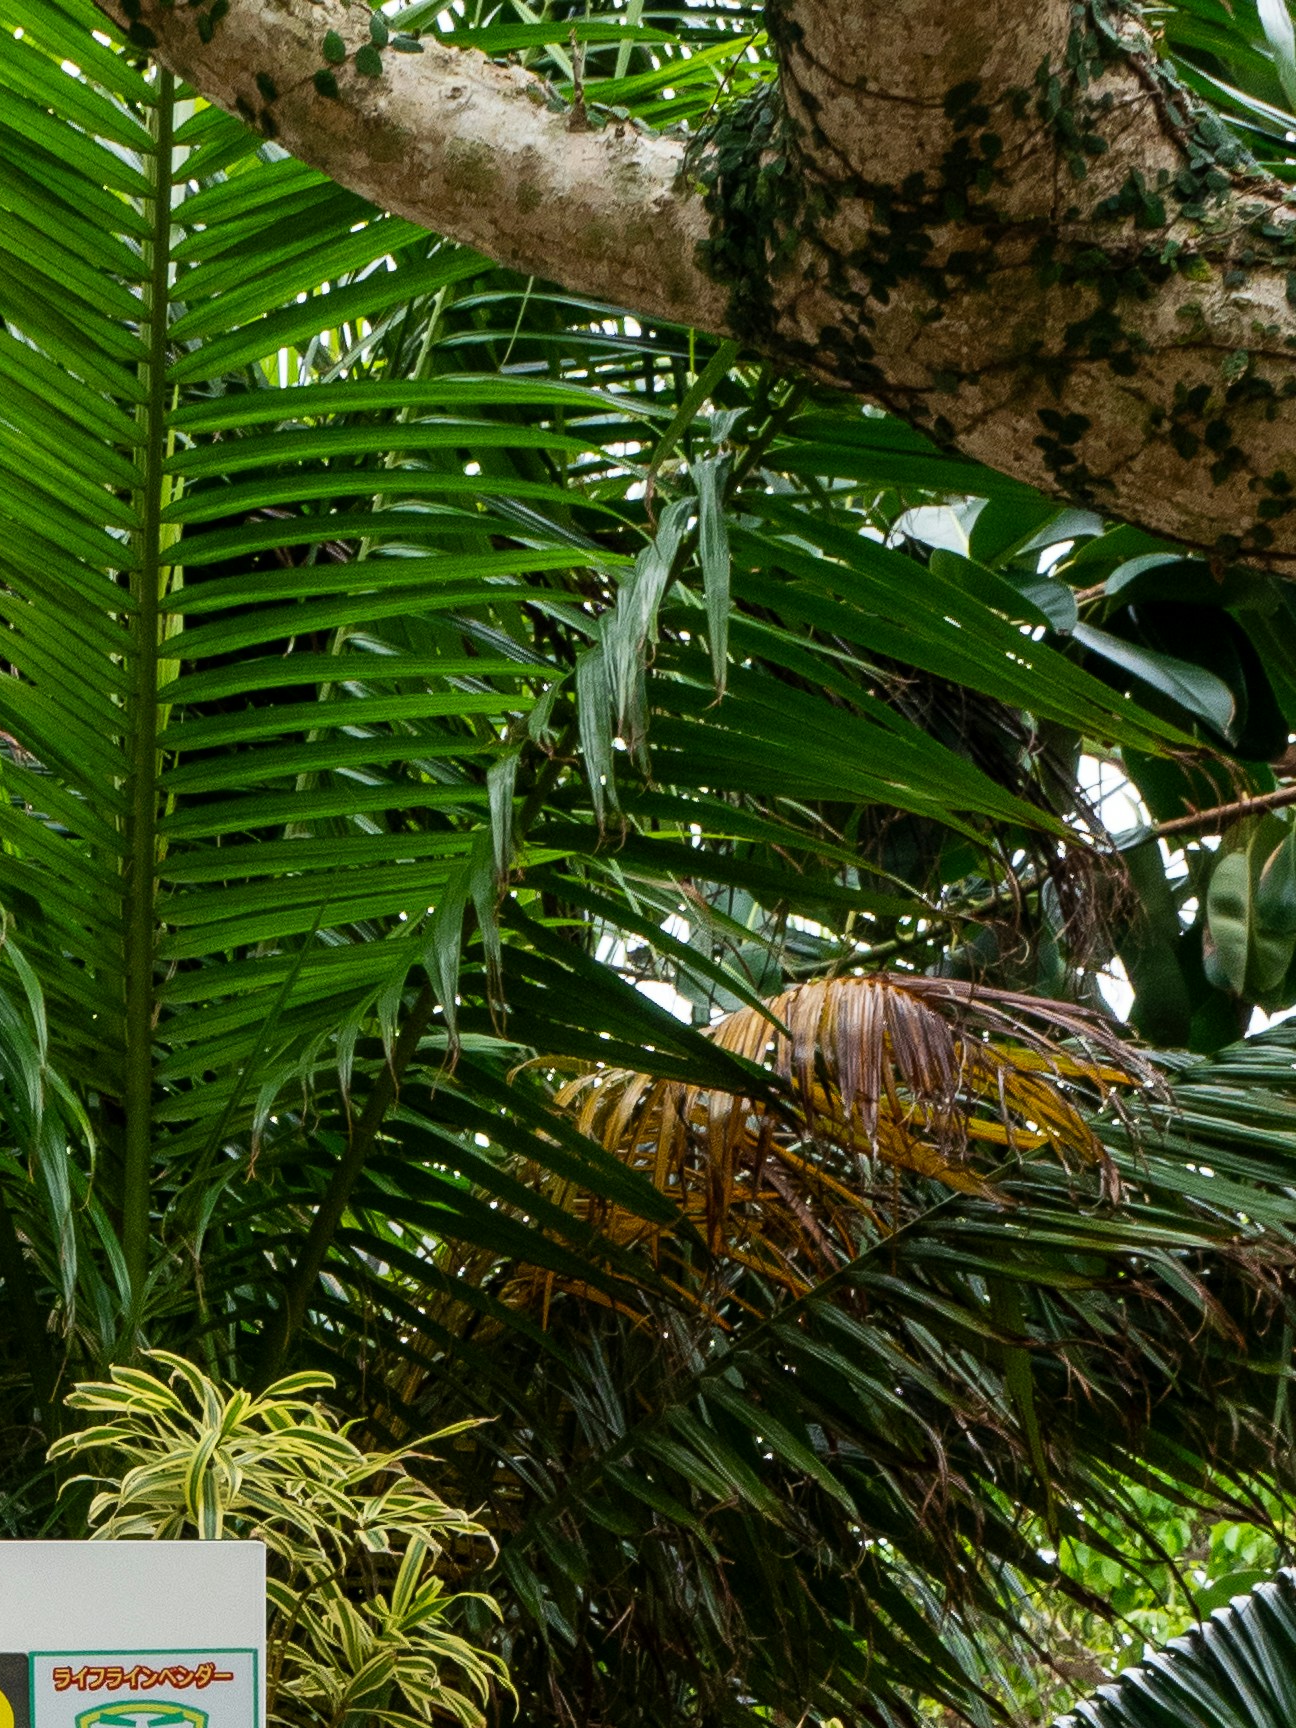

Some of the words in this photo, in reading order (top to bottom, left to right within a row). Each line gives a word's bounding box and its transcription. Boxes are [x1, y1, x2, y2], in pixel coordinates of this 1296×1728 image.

[54, 1662, 233, 1691] ライフラインベンダー
